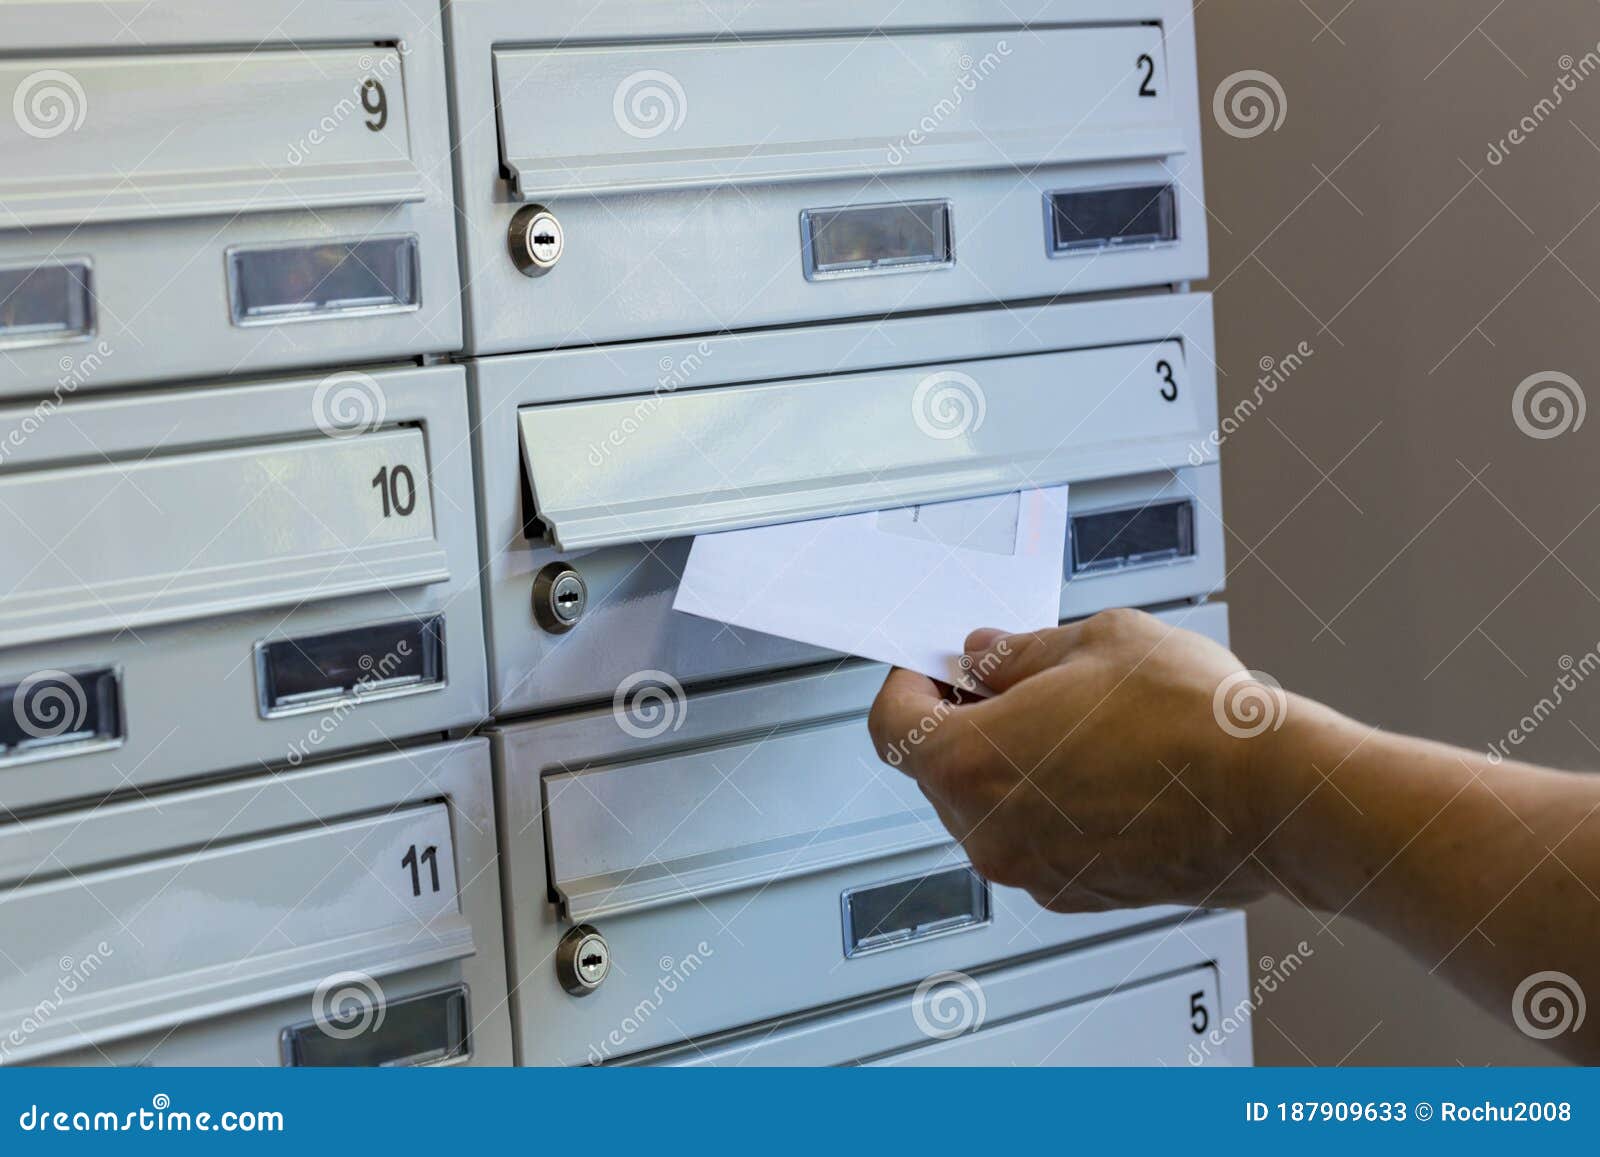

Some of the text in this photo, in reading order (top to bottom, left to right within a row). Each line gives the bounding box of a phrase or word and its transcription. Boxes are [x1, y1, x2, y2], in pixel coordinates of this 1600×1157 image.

[1137, 54, 1156, 97] 2
[361, 79, 388, 132] 9
[1156, 360, 1178, 402] 3
[372, 465, 415, 518] 10
[401, 844, 441, 897] 11
[1190, 990, 1208, 1034] 5
